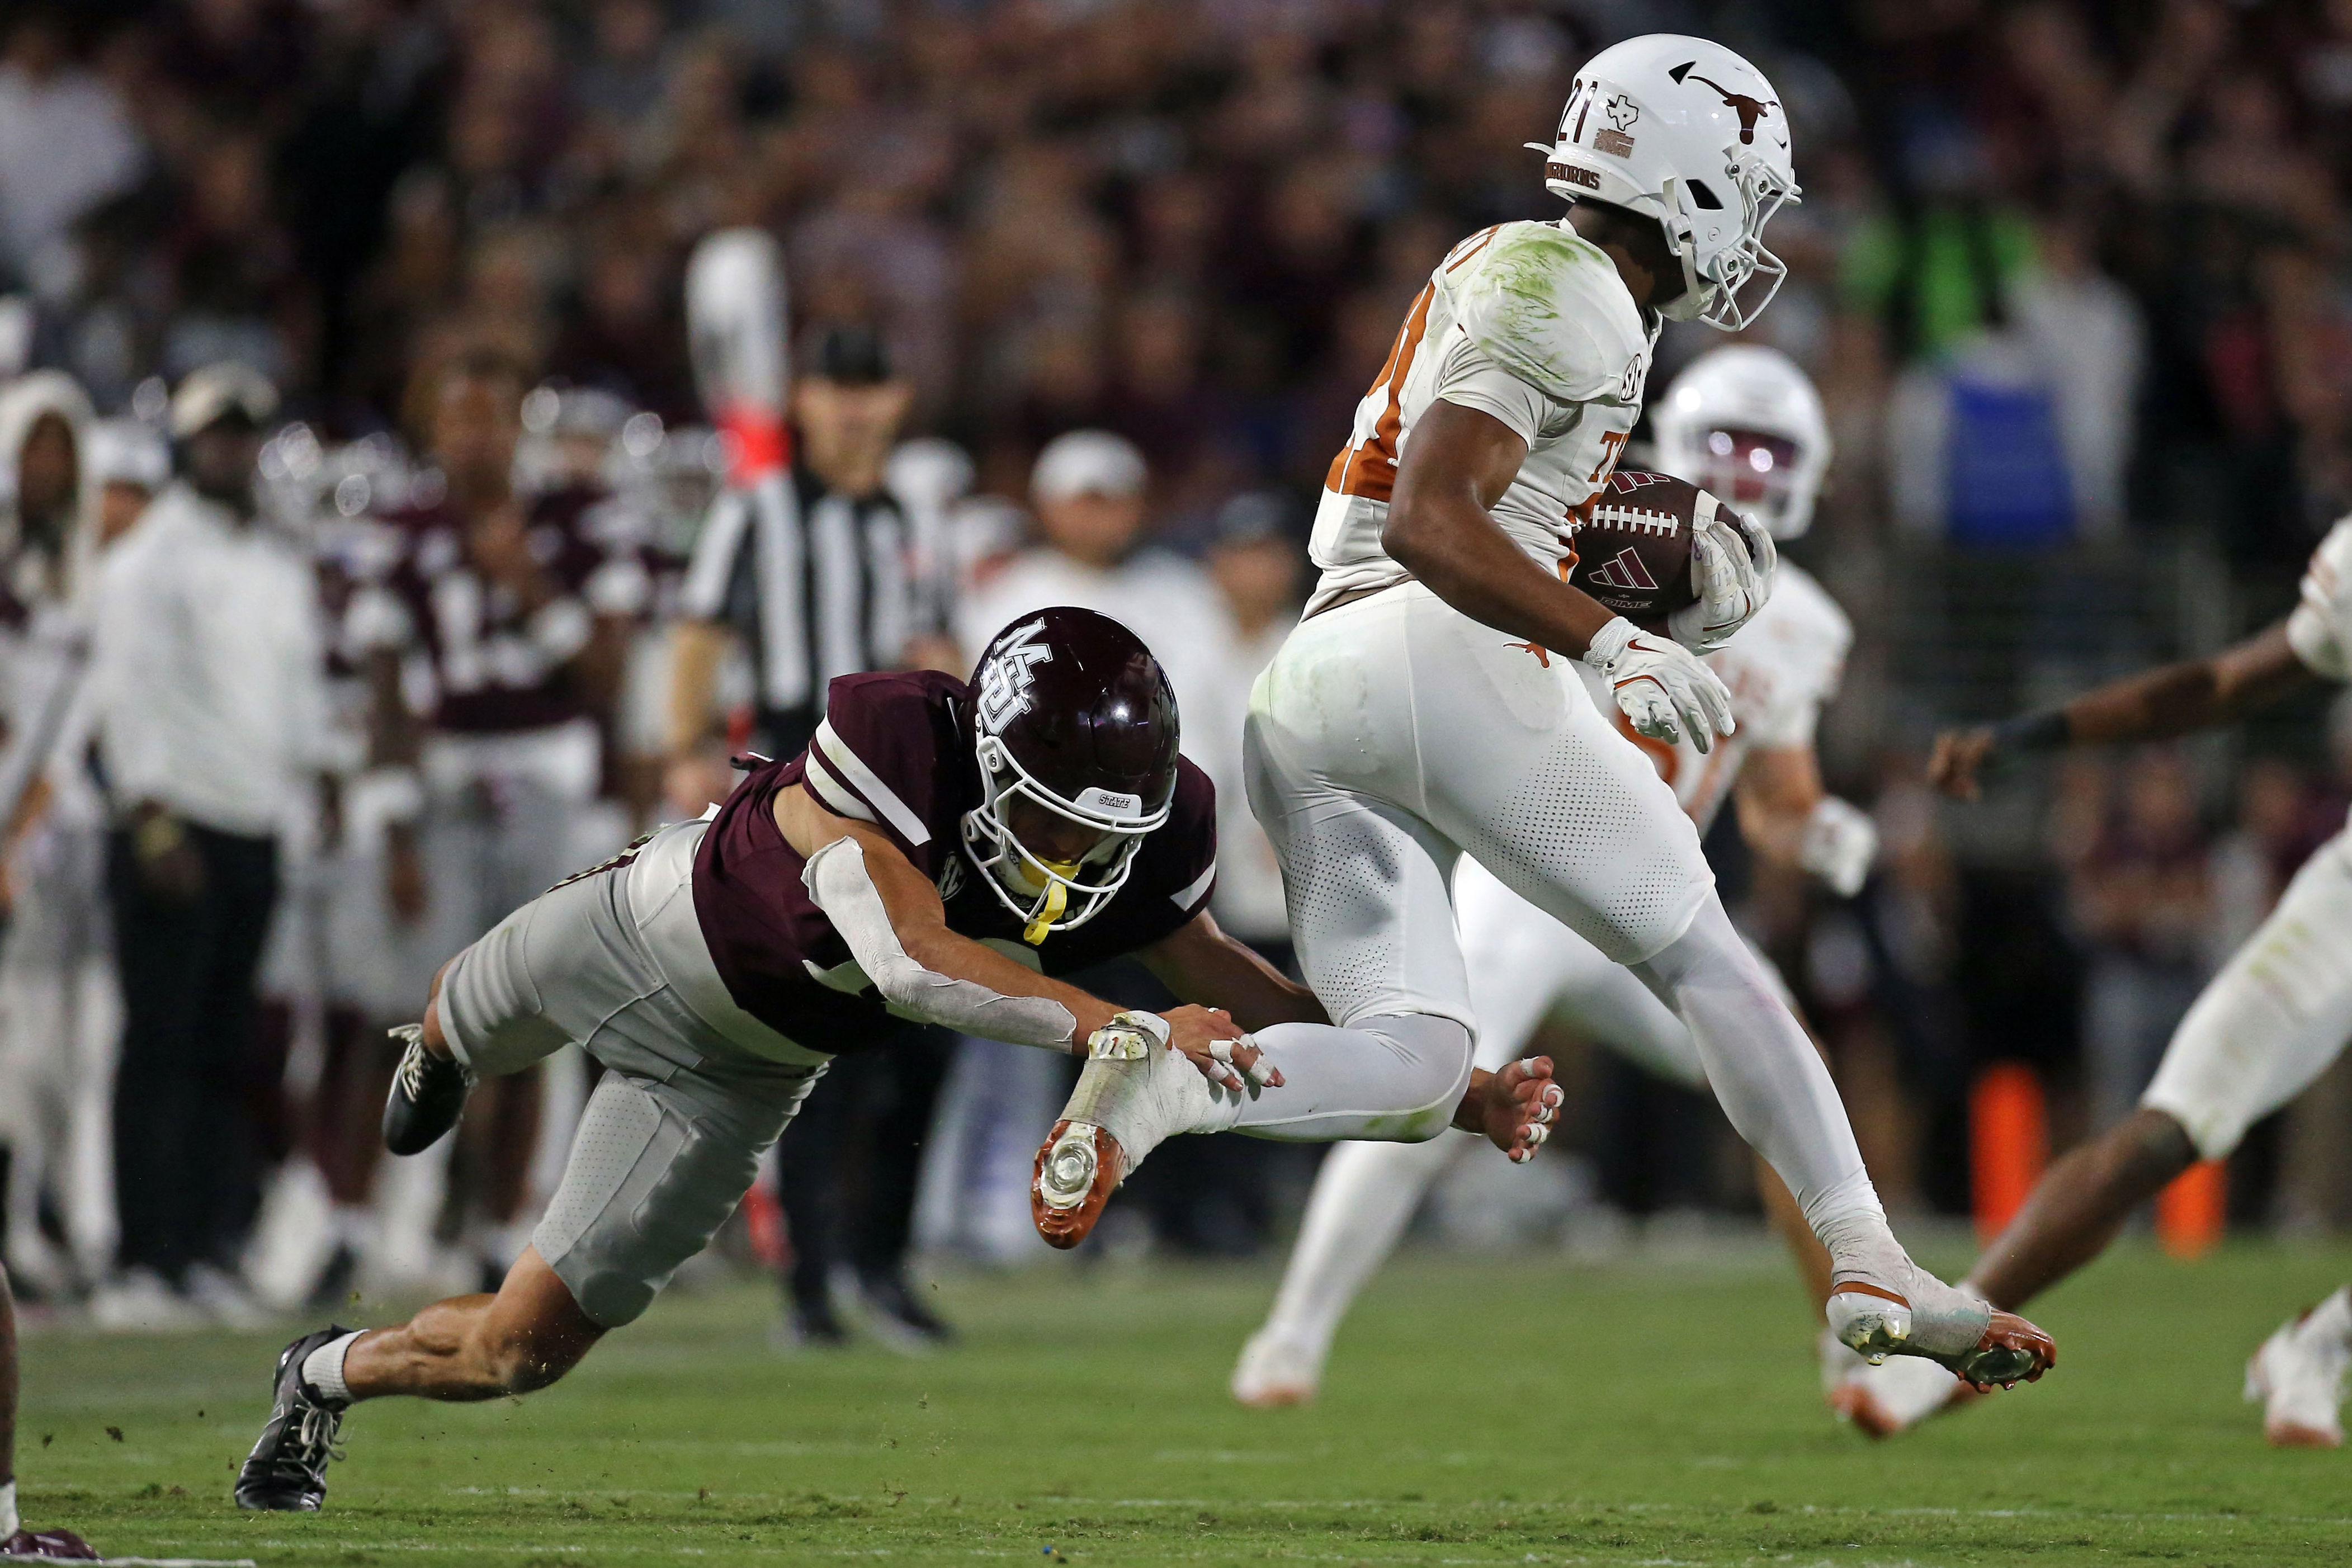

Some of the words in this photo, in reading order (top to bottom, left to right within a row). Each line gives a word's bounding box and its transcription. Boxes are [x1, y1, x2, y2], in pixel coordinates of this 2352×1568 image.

[1557, 78, 1598, 143] 21
[1599, 596, 1652, 609] DIME
[1099, 794, 1130, 809] STATE
